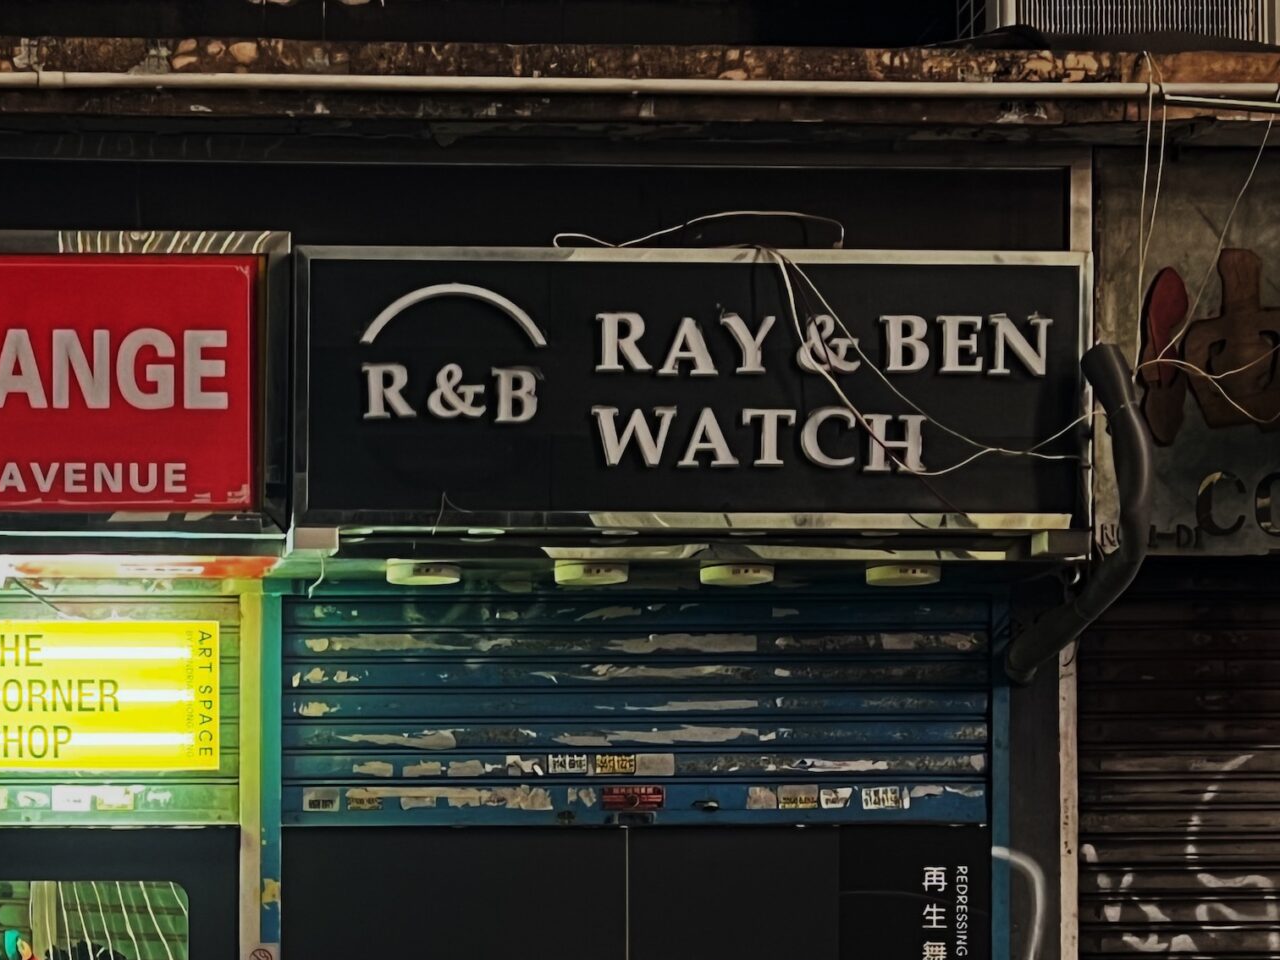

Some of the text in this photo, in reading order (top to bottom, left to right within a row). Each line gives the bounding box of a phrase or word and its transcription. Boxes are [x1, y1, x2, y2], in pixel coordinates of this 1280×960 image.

[594, 310, 1054, 378] RAY & BEN
[589, 405, 927, 474] WATCH
[198, 629, 213, 757] ART SPACE
[954, 865, 969, 957] REDRESSING
